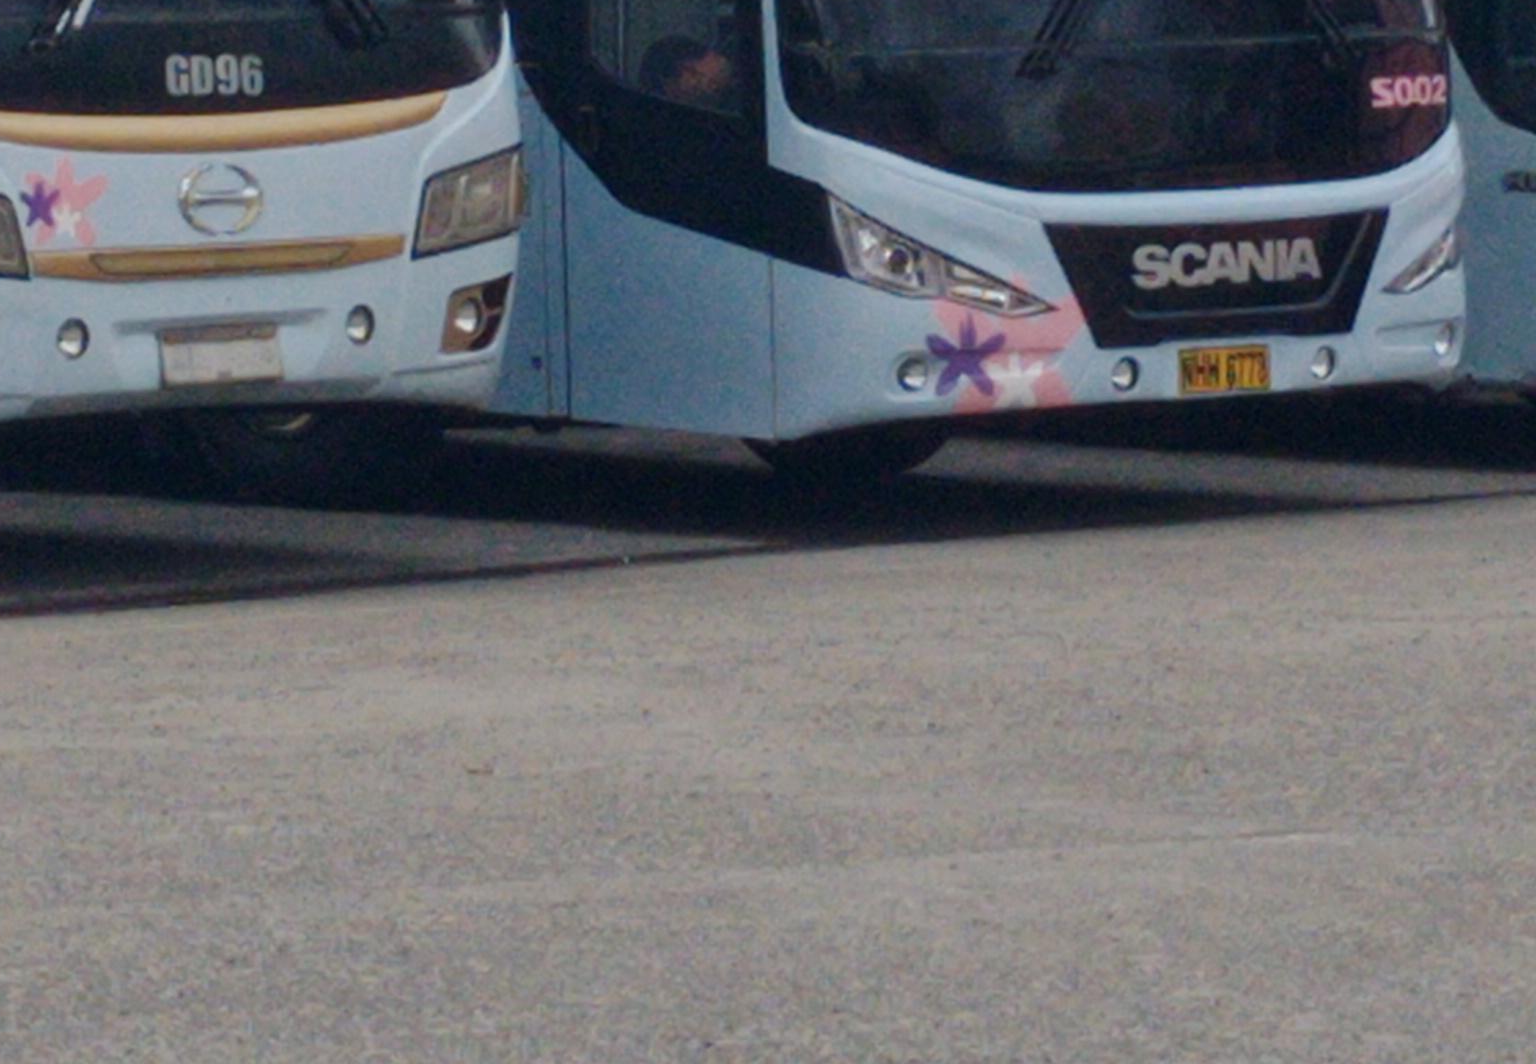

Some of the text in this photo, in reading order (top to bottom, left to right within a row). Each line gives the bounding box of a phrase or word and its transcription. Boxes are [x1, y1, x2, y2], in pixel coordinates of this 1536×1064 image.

[165, 53, 264, 96] GD96
[1370, 74, 1447, 108] S002
[1131, 238, 1322, 290] SCANIA
